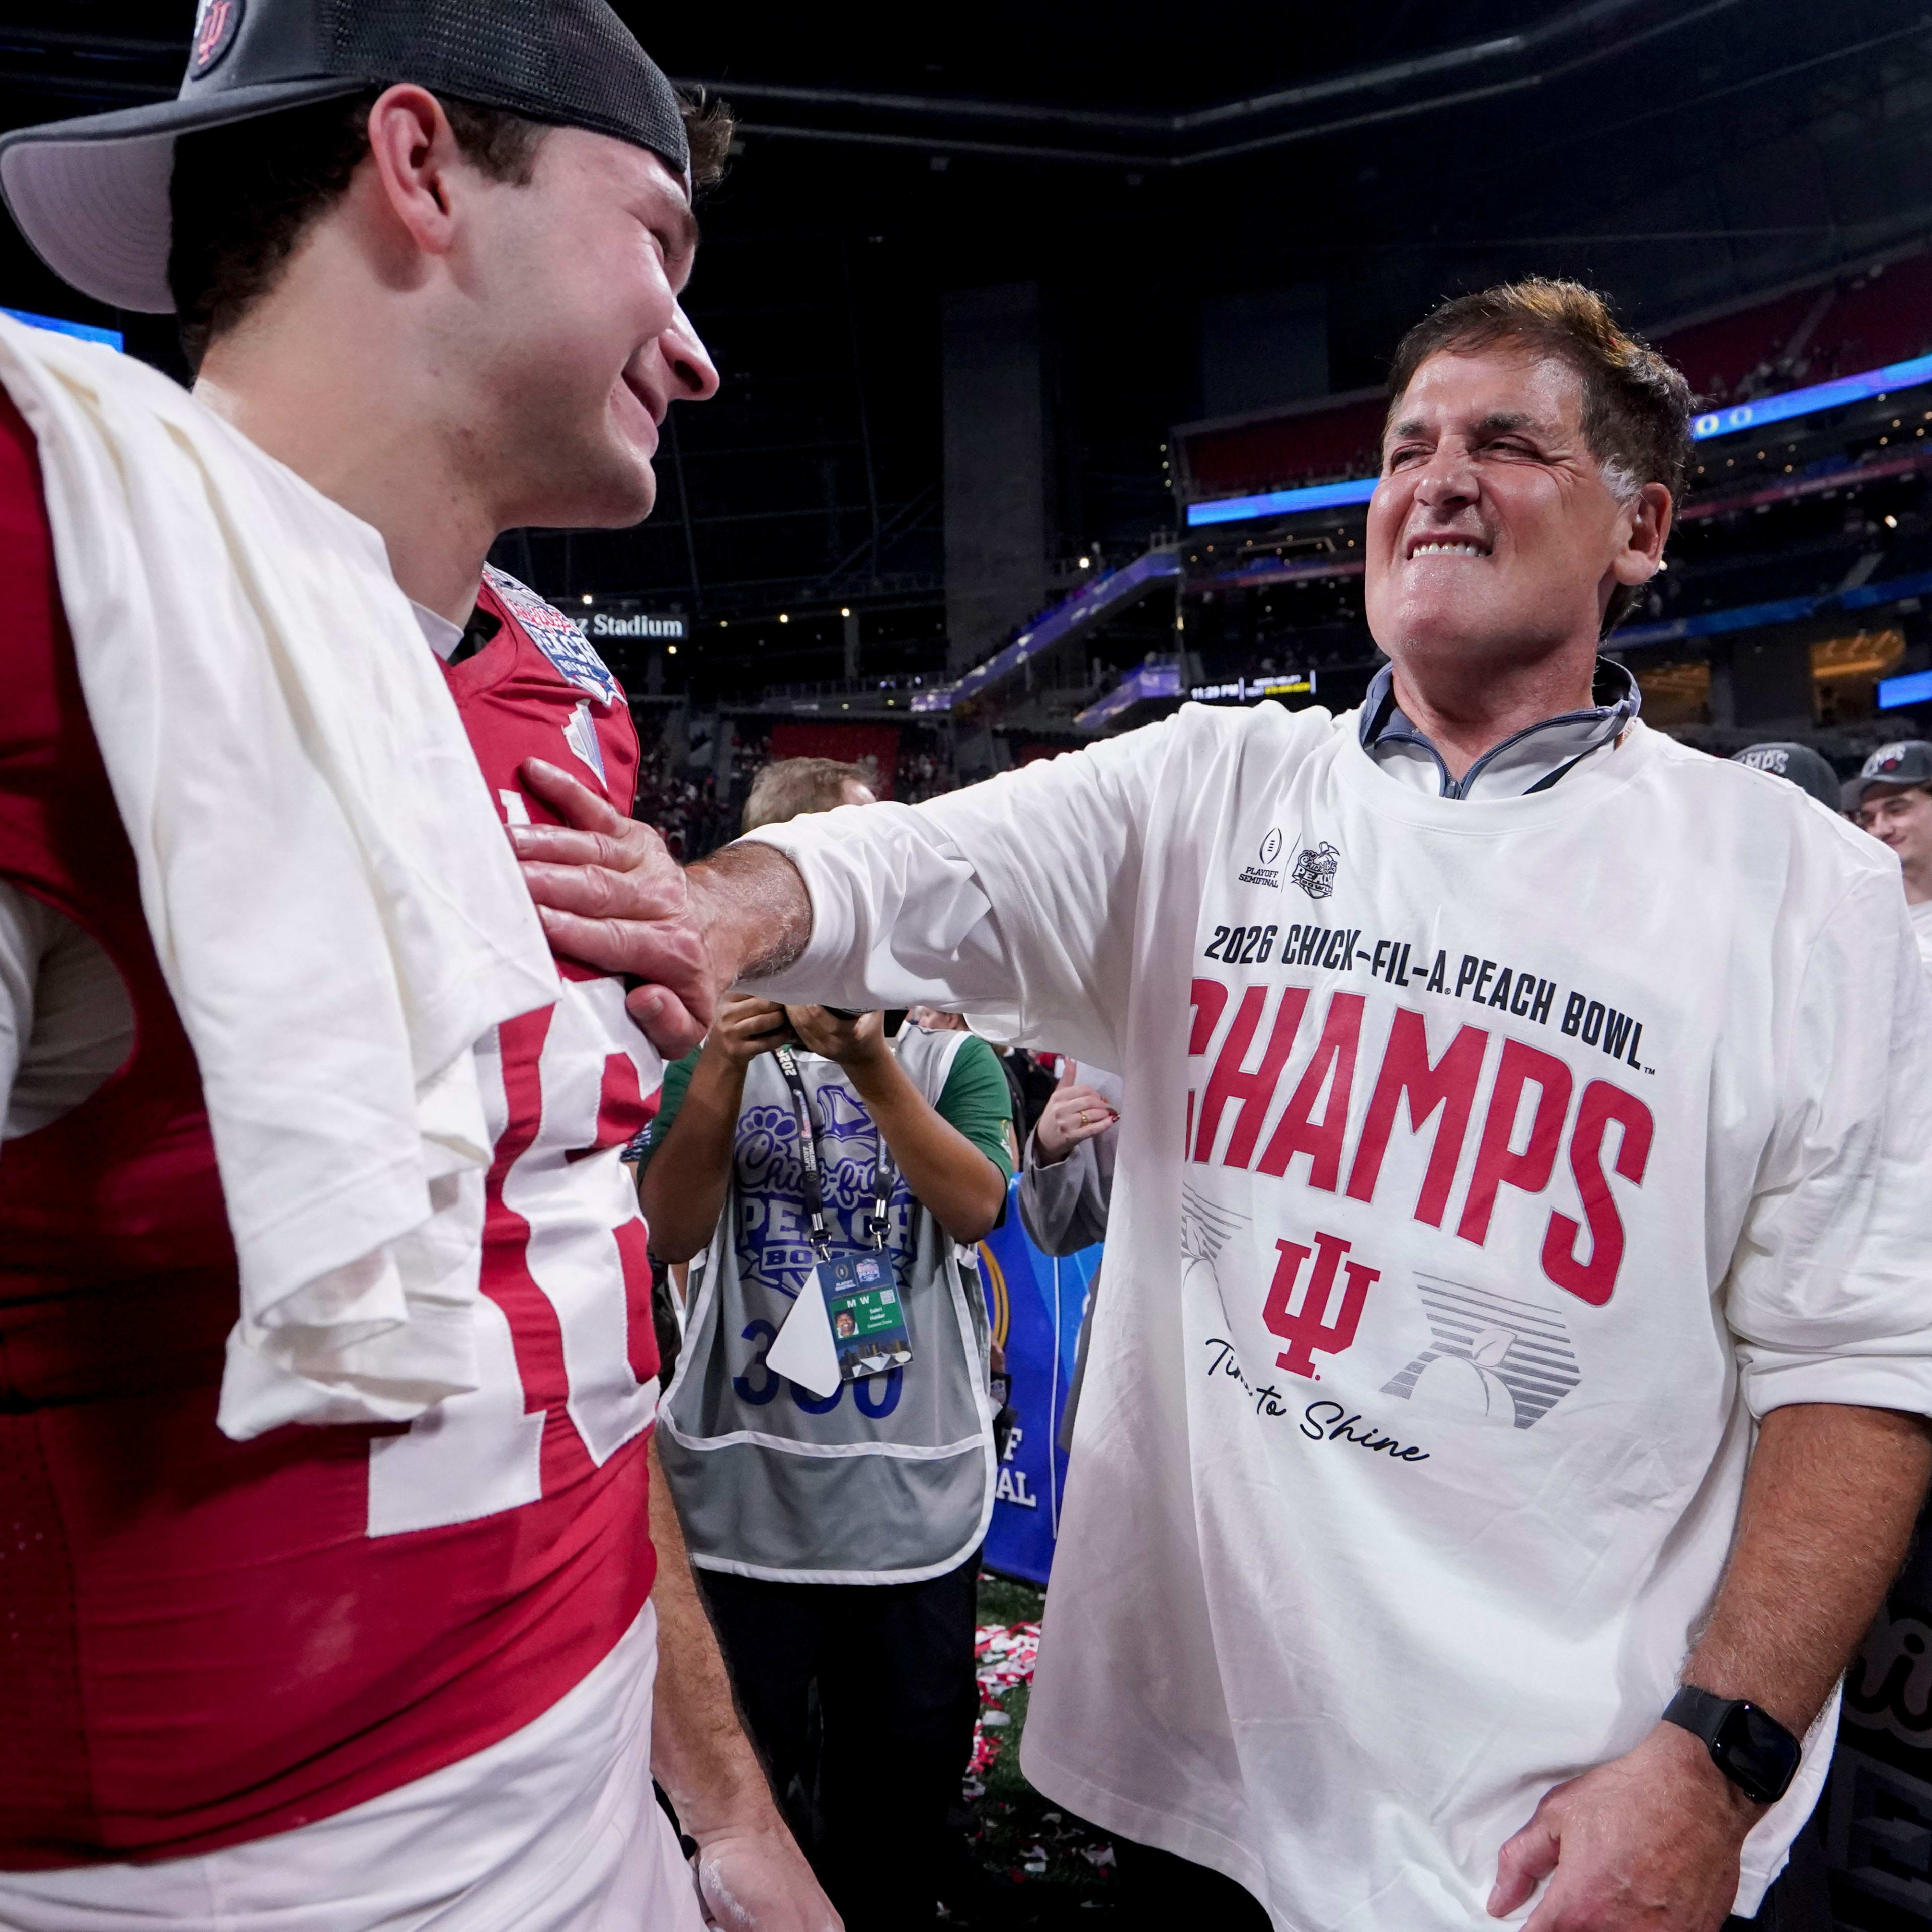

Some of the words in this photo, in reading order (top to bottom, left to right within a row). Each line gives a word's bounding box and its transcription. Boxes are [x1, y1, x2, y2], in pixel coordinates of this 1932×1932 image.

[593, 613, 683, 637] Stadium
[1245, 867, 1279, 878] PLAYOFF
[1239, 874, 1279, 888] SEMIFINAL
[1301, 880, 1330, 892] BOWL
[1204, 925, 1278, 964] 2026
[1455, 954, 1557, 1025] PEACH
[846, 1299, 857, 1308] M
[859, 1296, 870, 1305] W
[1256, 1385, 1287, 1416] to
[1299, 1401, 1430, 1462] Shine
